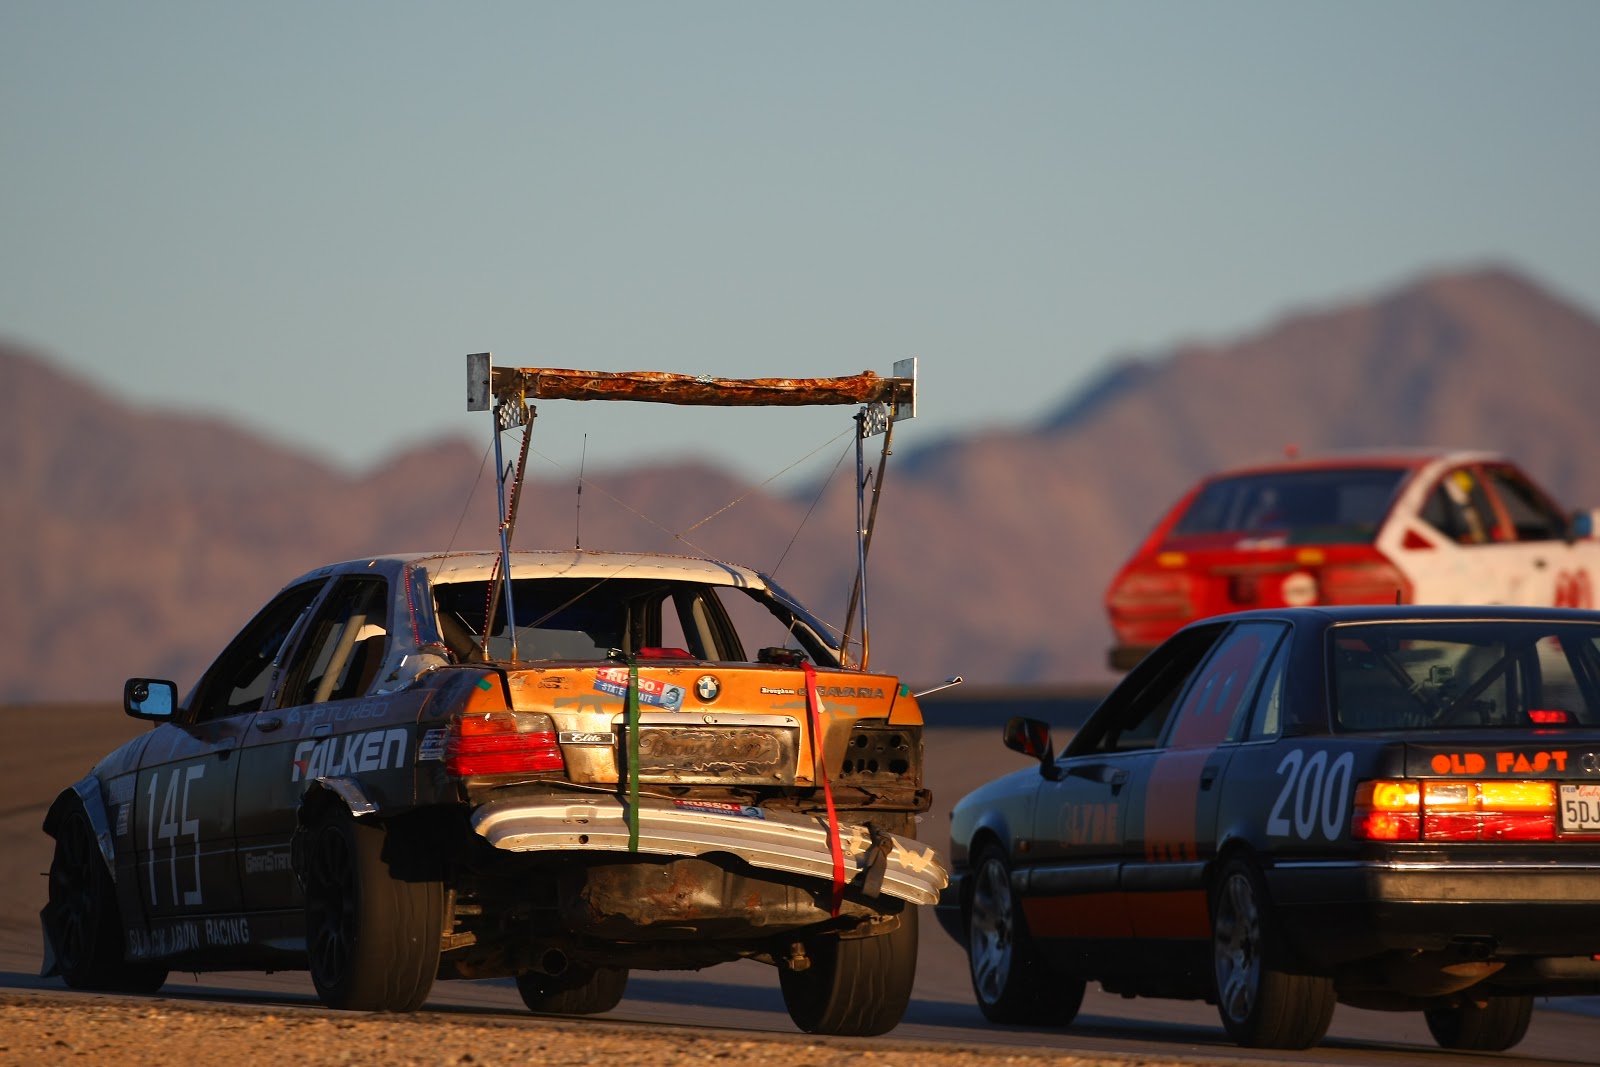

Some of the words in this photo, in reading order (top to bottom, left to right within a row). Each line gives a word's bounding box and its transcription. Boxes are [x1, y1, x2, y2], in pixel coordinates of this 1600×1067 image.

[601, 682, 625, 696] STATE
[606, 671, 655, 691] RUSO
[571, 733, 602, 742] Elite
[291, 728, 408, 782] FALKEN
[1431, 753, 1486, 774] OLD
[1496, 751, 1568, 773] FAST
[682, 801, 732, 810] RUSSO
[1266, 749, 1354, 841] 200
[147, 764, 205, 906] 145
[129, 928, 166, 956] BLACK
[171, 921, 200, 951] IRON
[205, 917, 250, 946] RACING
